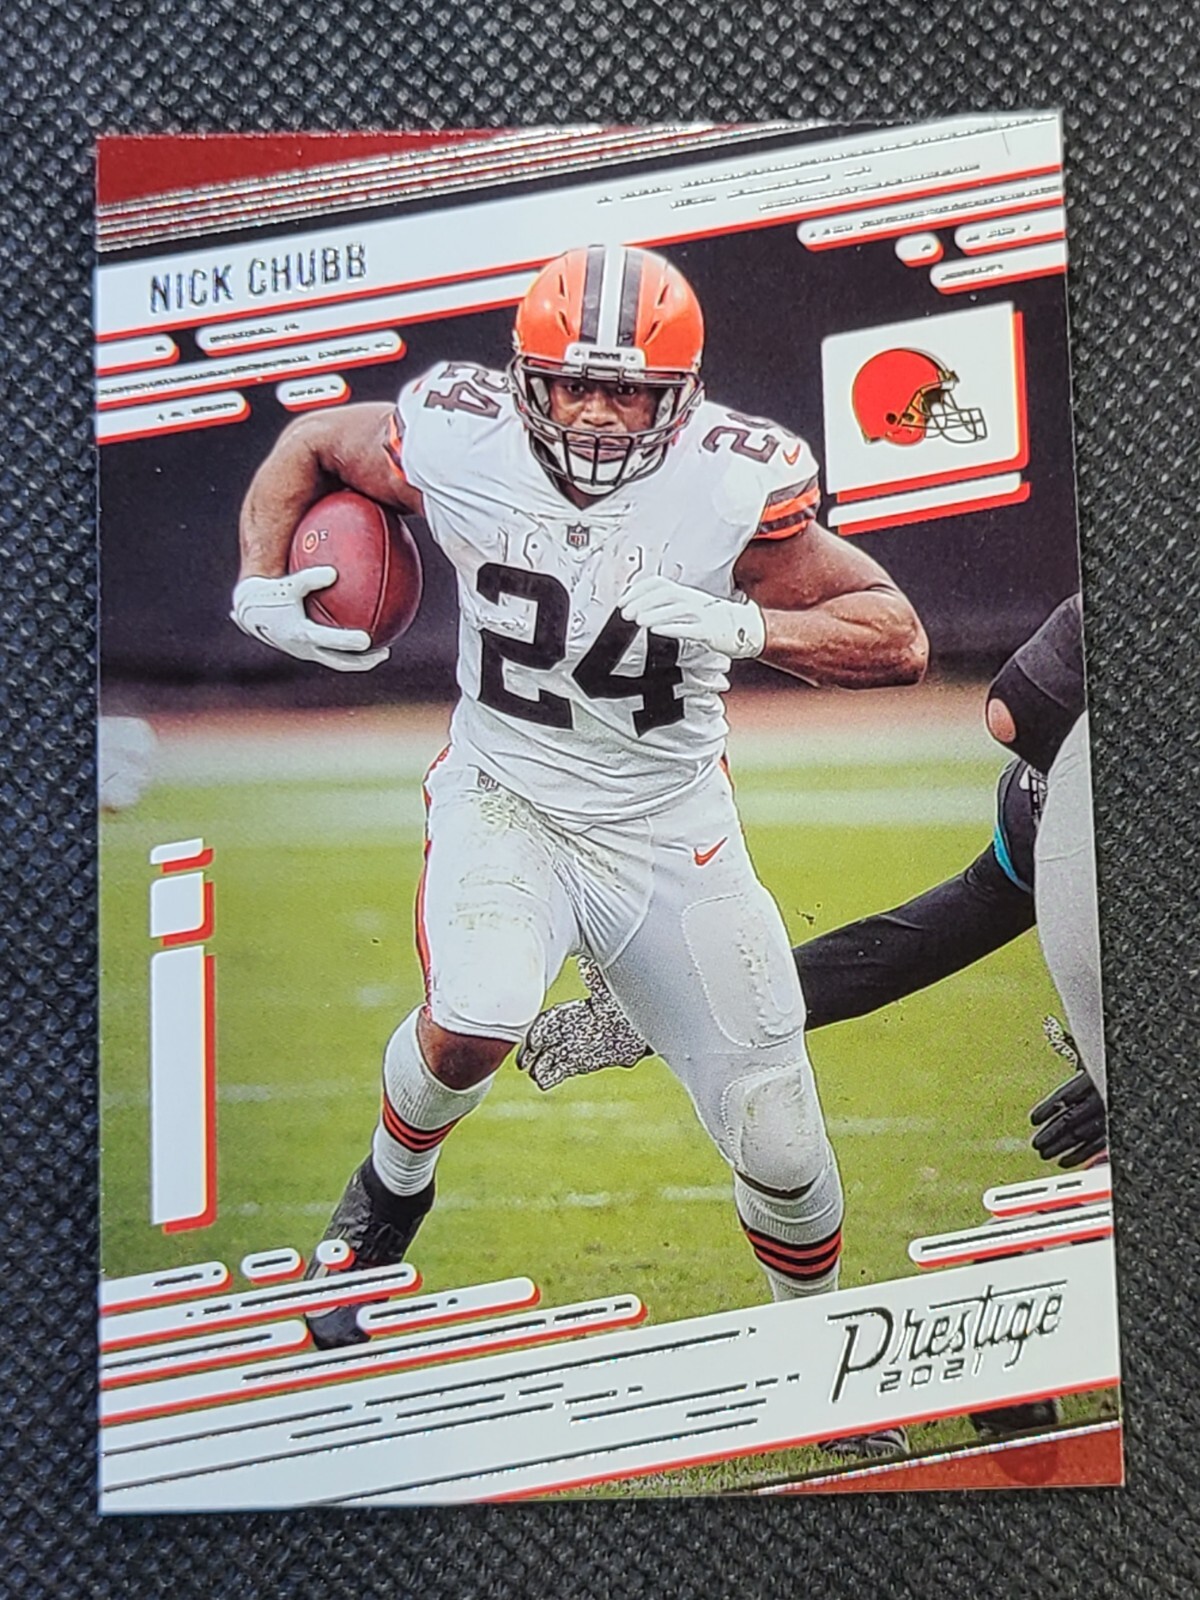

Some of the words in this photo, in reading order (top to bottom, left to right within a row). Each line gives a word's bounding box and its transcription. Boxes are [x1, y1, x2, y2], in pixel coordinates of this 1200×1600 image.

[149, 263, 235, 314] NICK
[248, 243, 367, 296] CHUBB
[476, 562, 686, 738] 24
[826, 1279, 1068, 1404] Prestige
[879, 1352, 983, 1393] 2021
